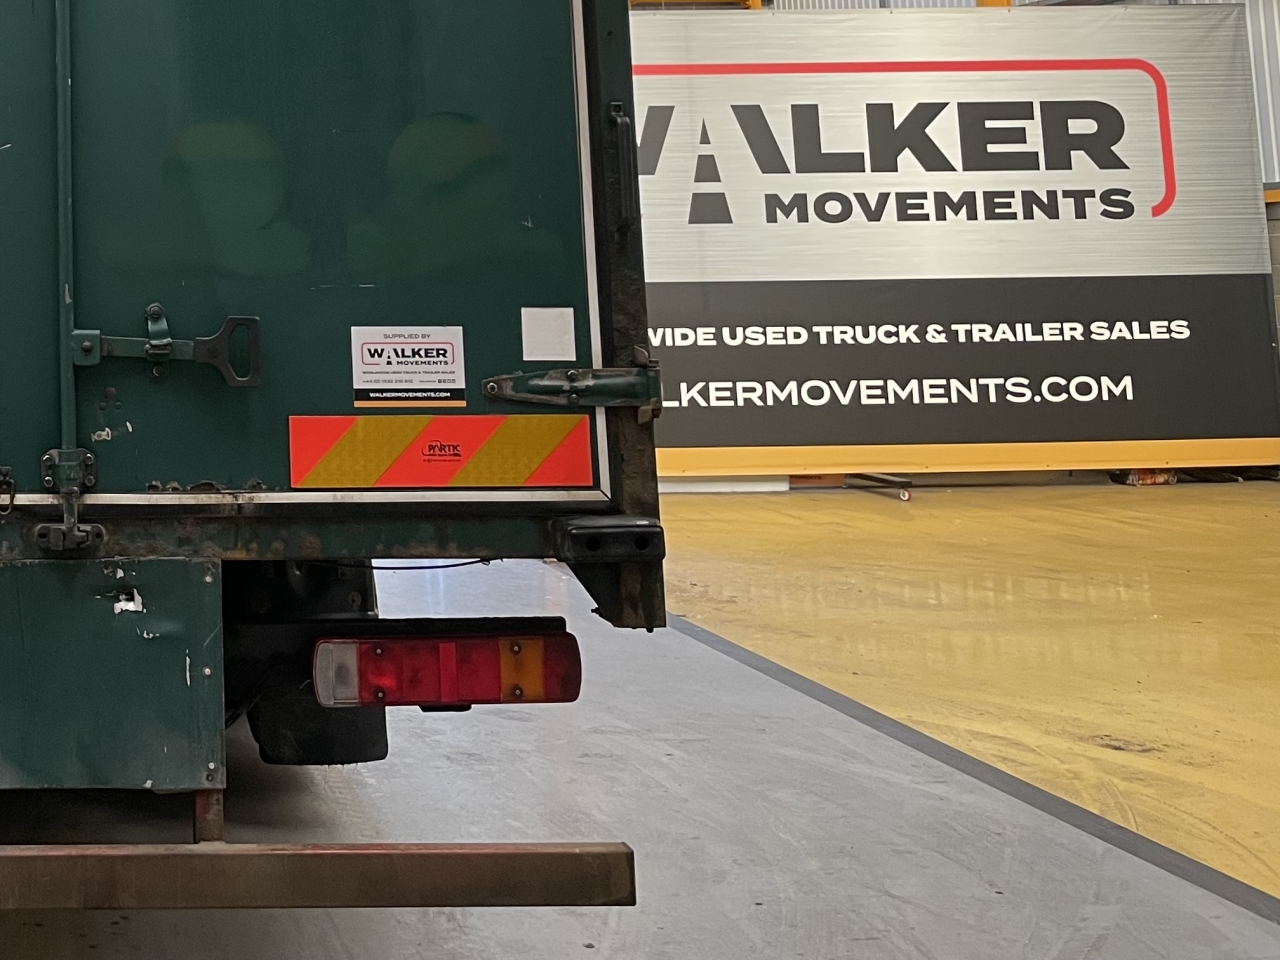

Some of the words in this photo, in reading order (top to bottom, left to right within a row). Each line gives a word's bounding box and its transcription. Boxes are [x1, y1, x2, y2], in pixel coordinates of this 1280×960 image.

[638, 101, 1129, 223] ALKER
[765, 189, 1135, 224] MOVEMENTS
[722, 326, 809, 346] USED
[812, 324, 920, 345] TRUCK
[925, 323, 948, 344] &
[951, 321, 1085, 343] TRAILER
[1089, 319, 1191, 341] SALES
[367, 347, 448, 365] WALKER
